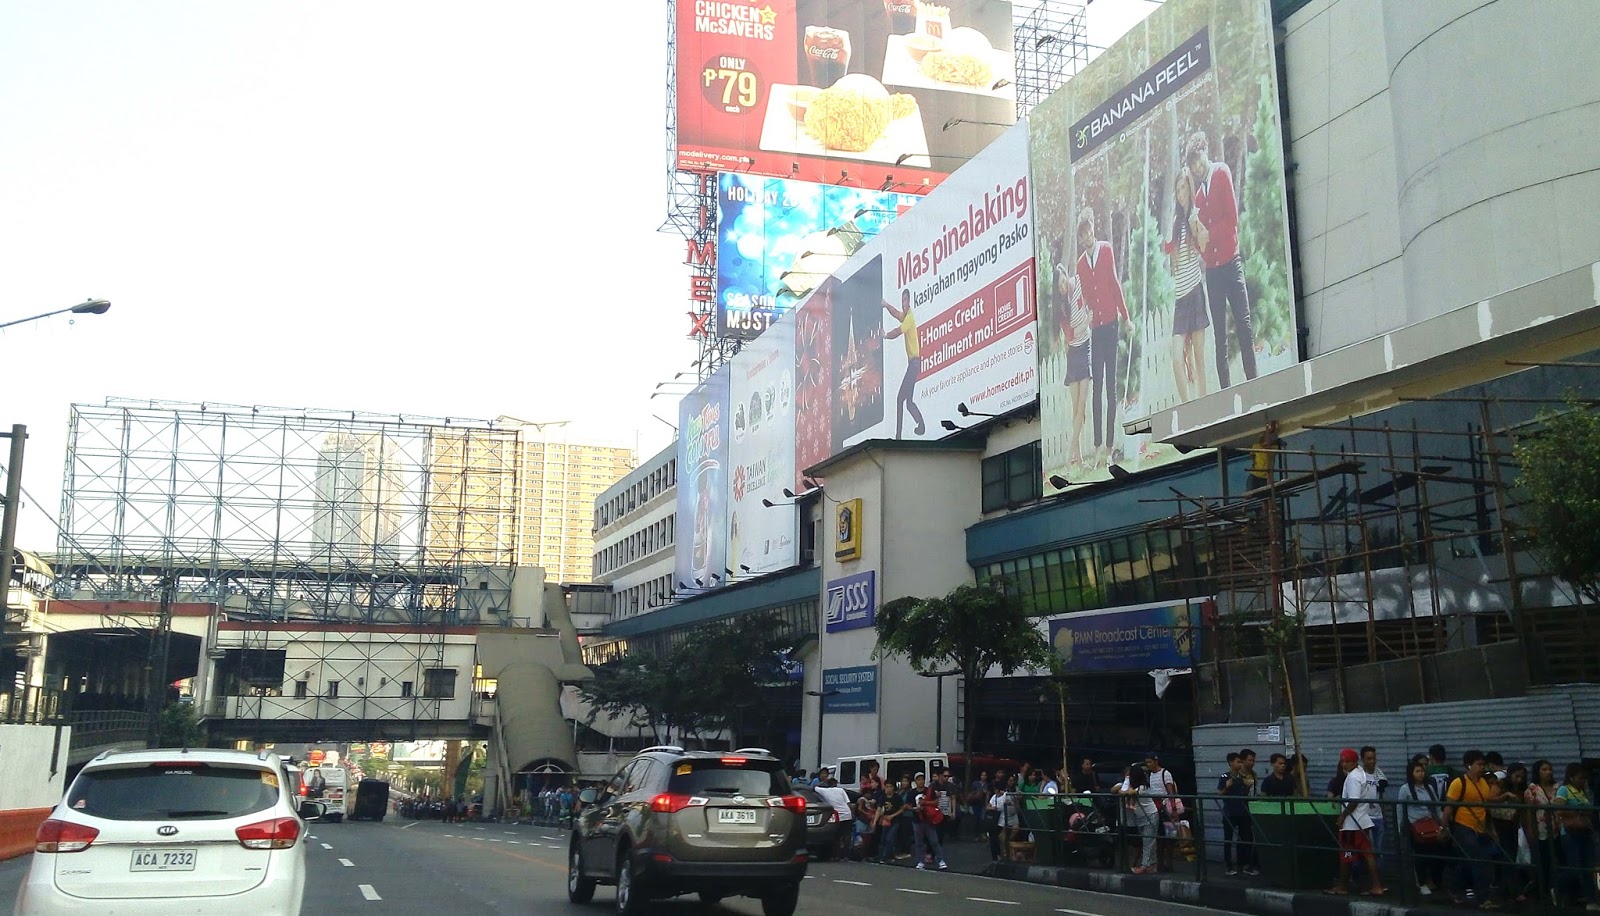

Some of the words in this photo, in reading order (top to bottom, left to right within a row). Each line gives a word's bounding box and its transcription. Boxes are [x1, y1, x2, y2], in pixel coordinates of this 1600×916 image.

[695, 0, 760, 22] CHICKEN
[695, 16, 774, 40] McSAVERS
[719, 56, 746, 70] ONLY
[1090, 82, 1155, 138] BANANA
[1156, 51, 1199, 92] PEEL
[898, 248, 930, 290] Mas
[933, 175, 1028, 275] pinalaking
[913, 269, 956, 308] kasiyahan
[956, 242, 998, 282] ngayong
[999, 224, 1028, 255] Pasko
[726, 292, 776, 310] SEASON
[997, 301, 1012, 315] HOME
[726, 309, 773, 331] MUST
[920, 319, 953, 349] i-Home
[955, 298, 985, 330] Credit
[997, 309, 1014, 324] CREDIT
[920, 332, 973, 373] installment
[974, 320, 994, 345] mo!
[990, 351, 1007, 368] phone
[969, 366, 1035, 405] www.homecredit.ph
[845, 580, 868, 612] SSS
[1074, 629, 1093, 645] RMN
[1095, 626, 1137, 643] Broadcast
[135, 853, 157, 866] ACA
[163, 852, 193, 866] 7232
